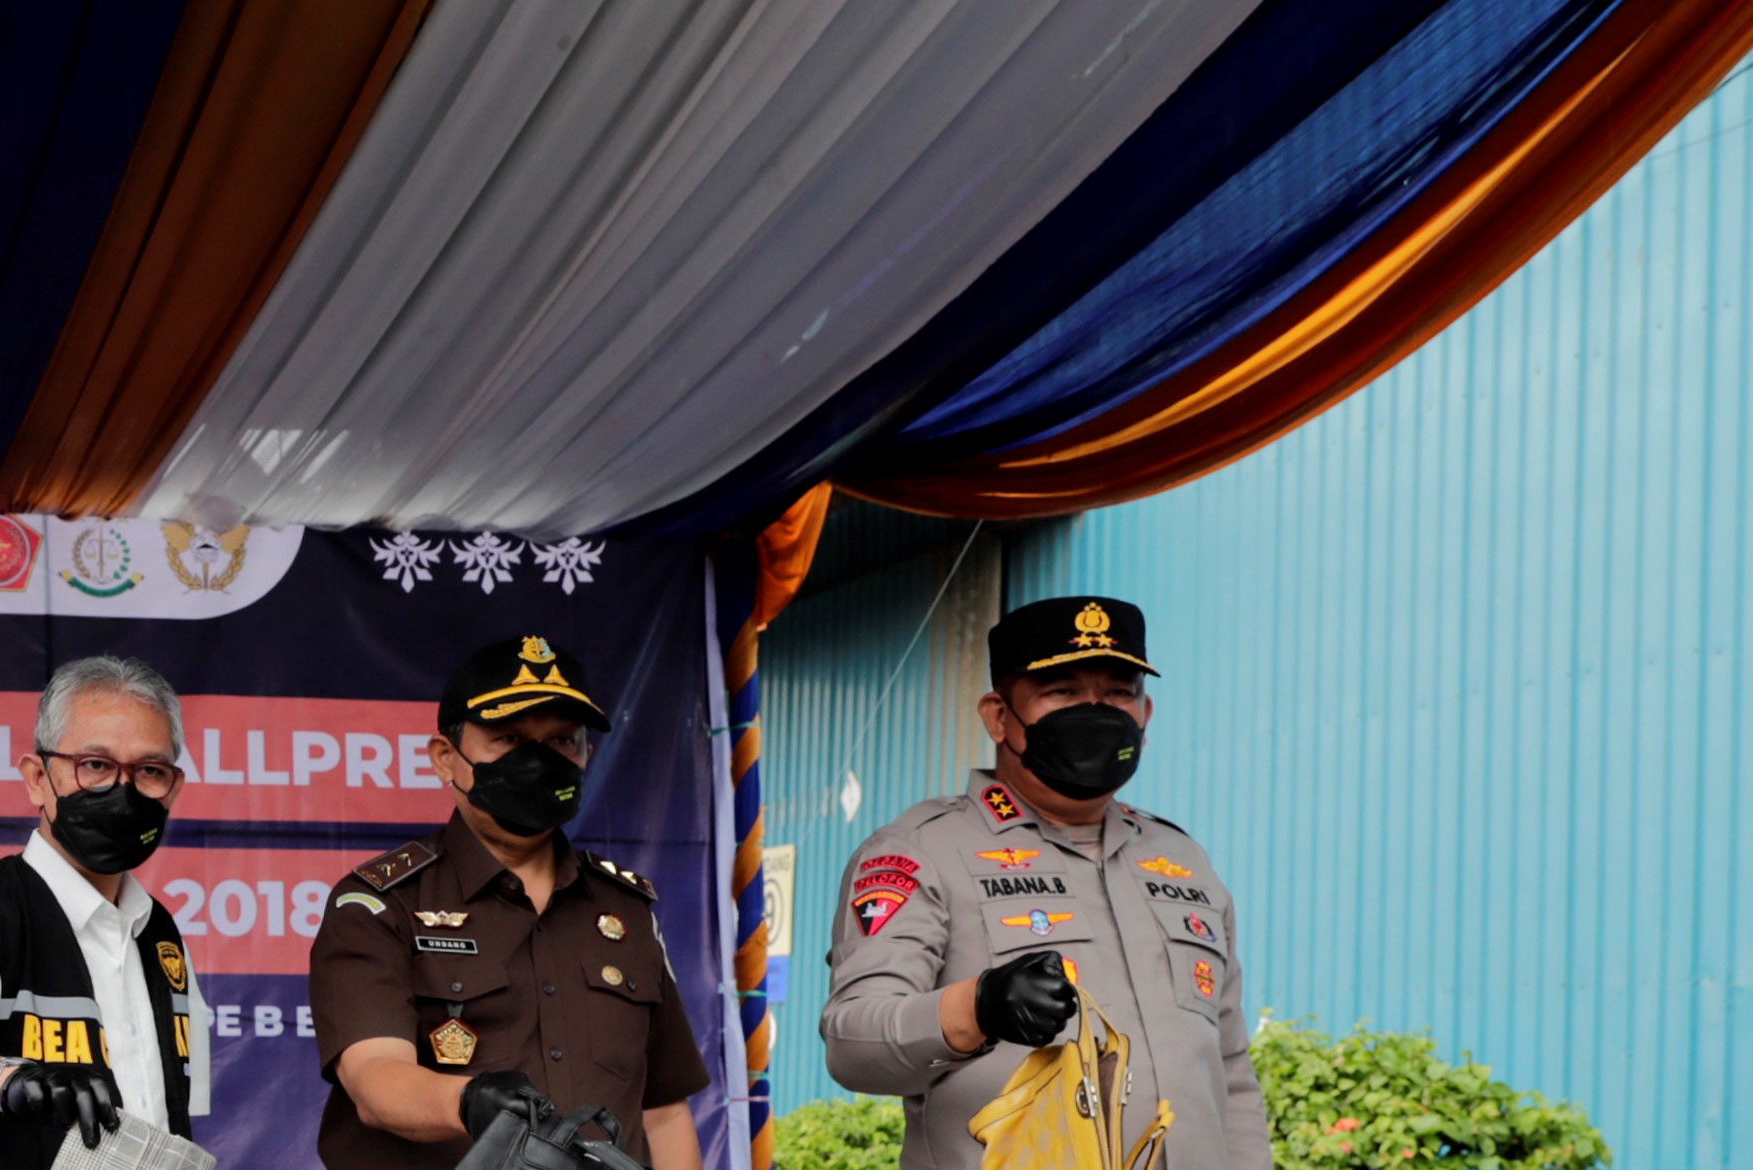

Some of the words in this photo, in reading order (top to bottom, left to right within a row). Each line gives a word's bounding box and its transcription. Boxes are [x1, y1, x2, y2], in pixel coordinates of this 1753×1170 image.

[980, 877, 1067, 898] TABANA.B
[1146, 882, 1212, 905] POLRI
[428, 940, 466, 949] UNDANG
[22, 1014, 93, 1064] BEA
